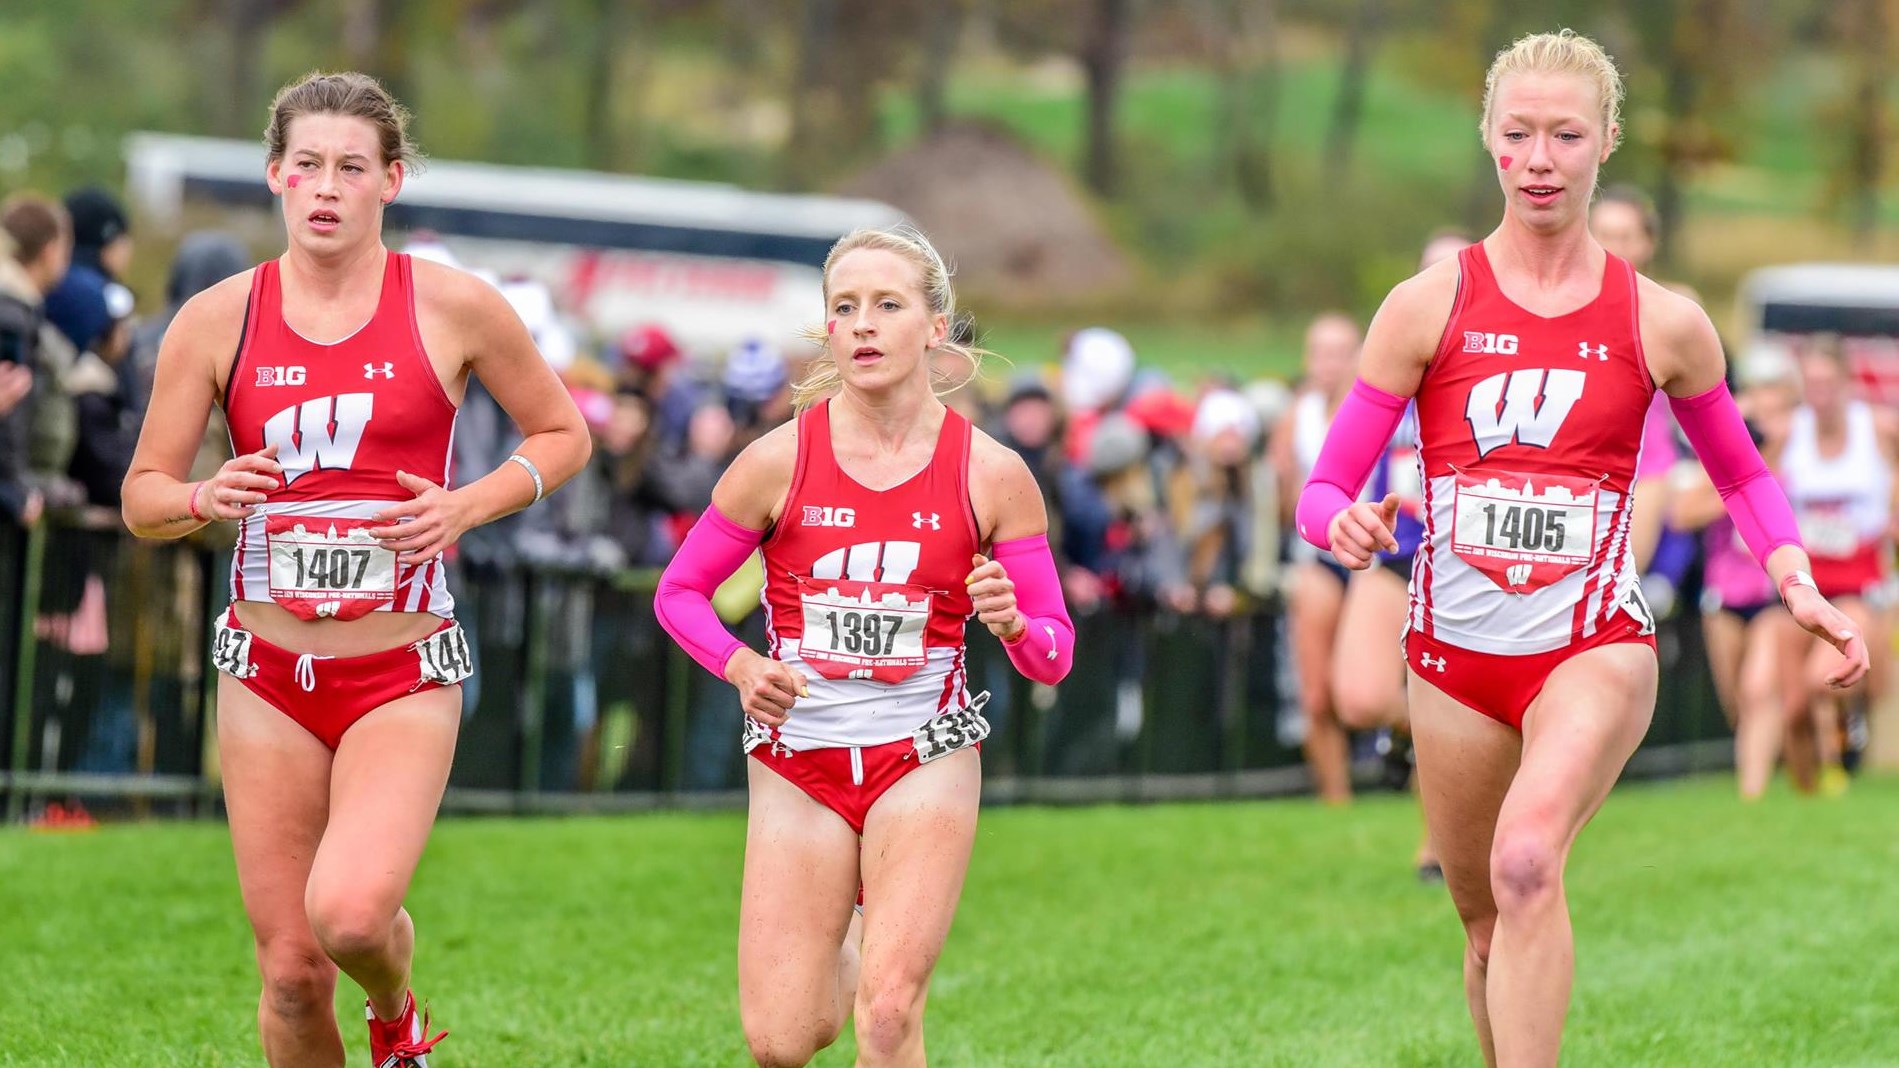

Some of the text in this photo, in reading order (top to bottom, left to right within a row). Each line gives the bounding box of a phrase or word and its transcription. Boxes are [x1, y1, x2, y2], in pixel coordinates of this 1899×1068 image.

[1464, 368, 1587, 460] W
[262, 392, 374, 488] W
[1483, 503, 1567, 552] 1405
[292, 549, 371, 589] 1407
[826, 611, 903, 656] 1397
